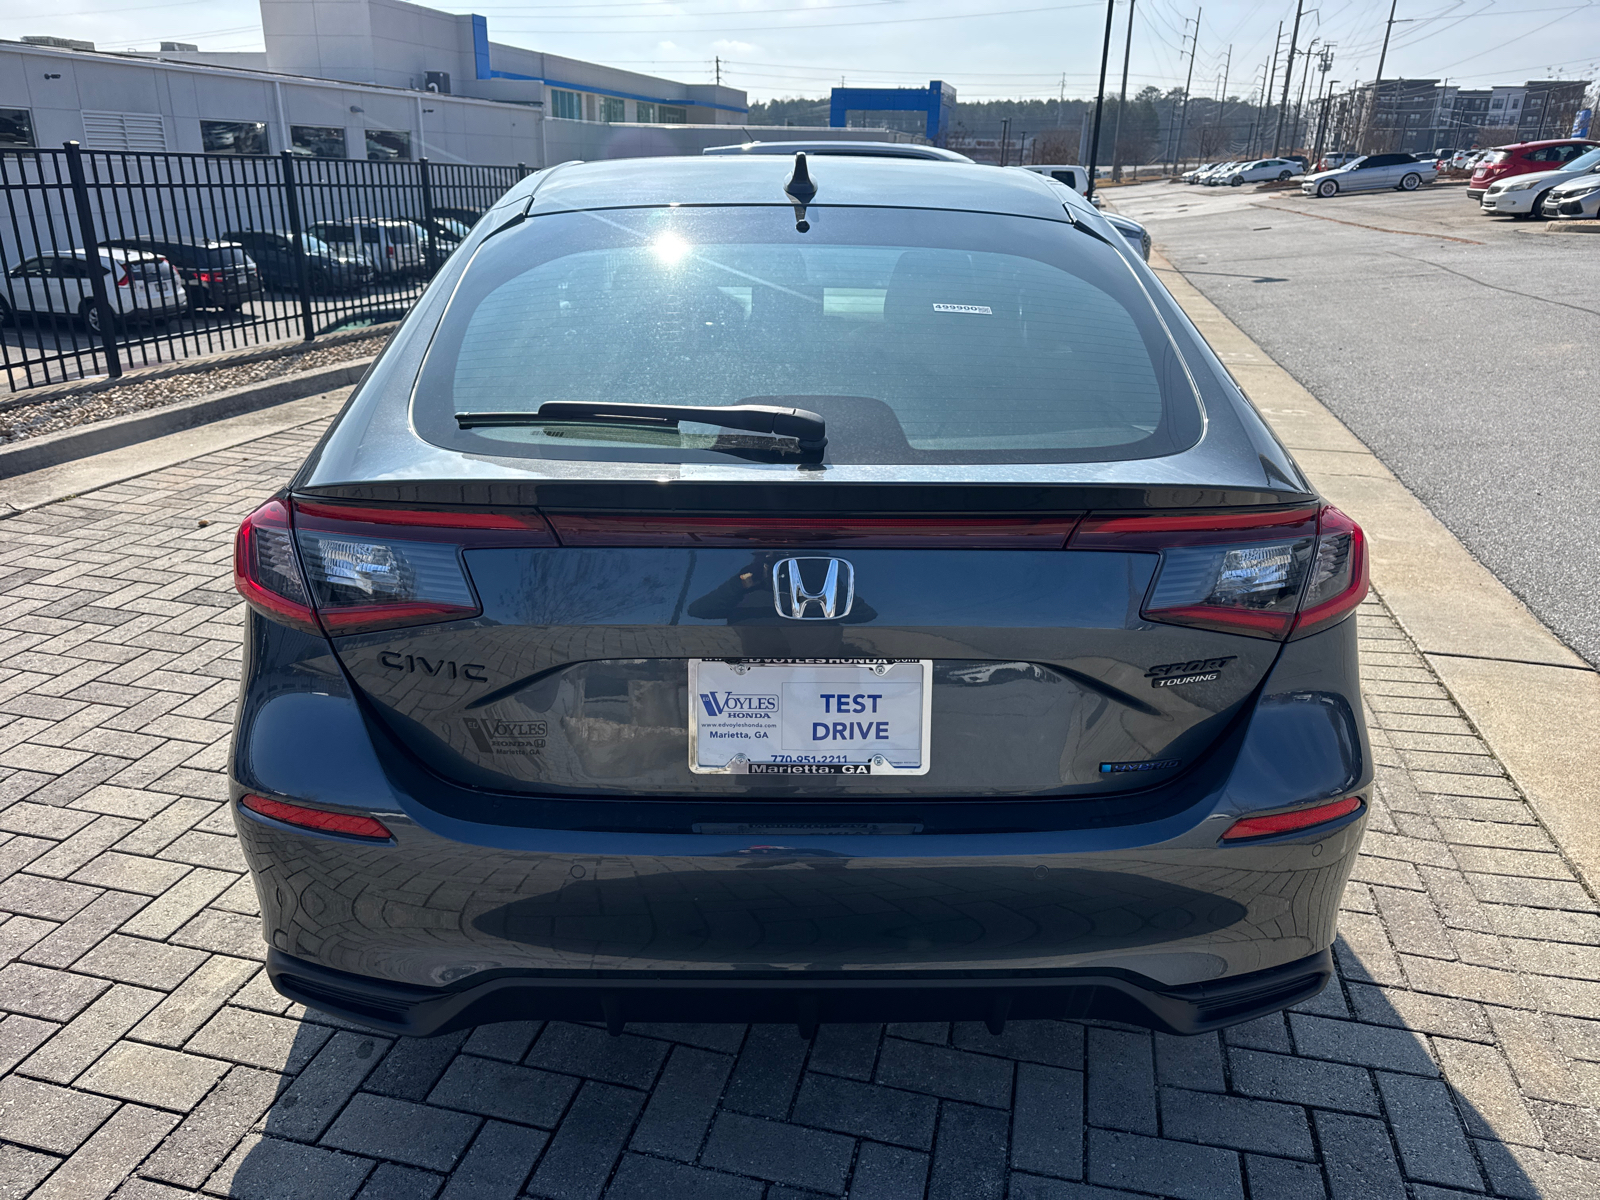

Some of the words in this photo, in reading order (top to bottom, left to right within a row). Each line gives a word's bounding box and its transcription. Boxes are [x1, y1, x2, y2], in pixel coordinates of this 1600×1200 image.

[376, 651, 488, 683] CIVIC
[1144, 655, 1238, 678] SPORT
[1159, 672, 1218, 687] TOURING
[709, 691, 776, 715] VOYLES
[820, 694, 883, 713] TEST
[480, 718, 546, 739] VOYLES
[709, 731, 752, 739] Marietta,
[754, 731, 769, 739] GA
[812, 722, 889, 741] DRIVE
[496, 748, 528, 756] Marietta,
[770, 754, 848, 763] 770-951-2211
[751, 764, 835, 774] Marietta,
[841, 764, 868, 774] GA
